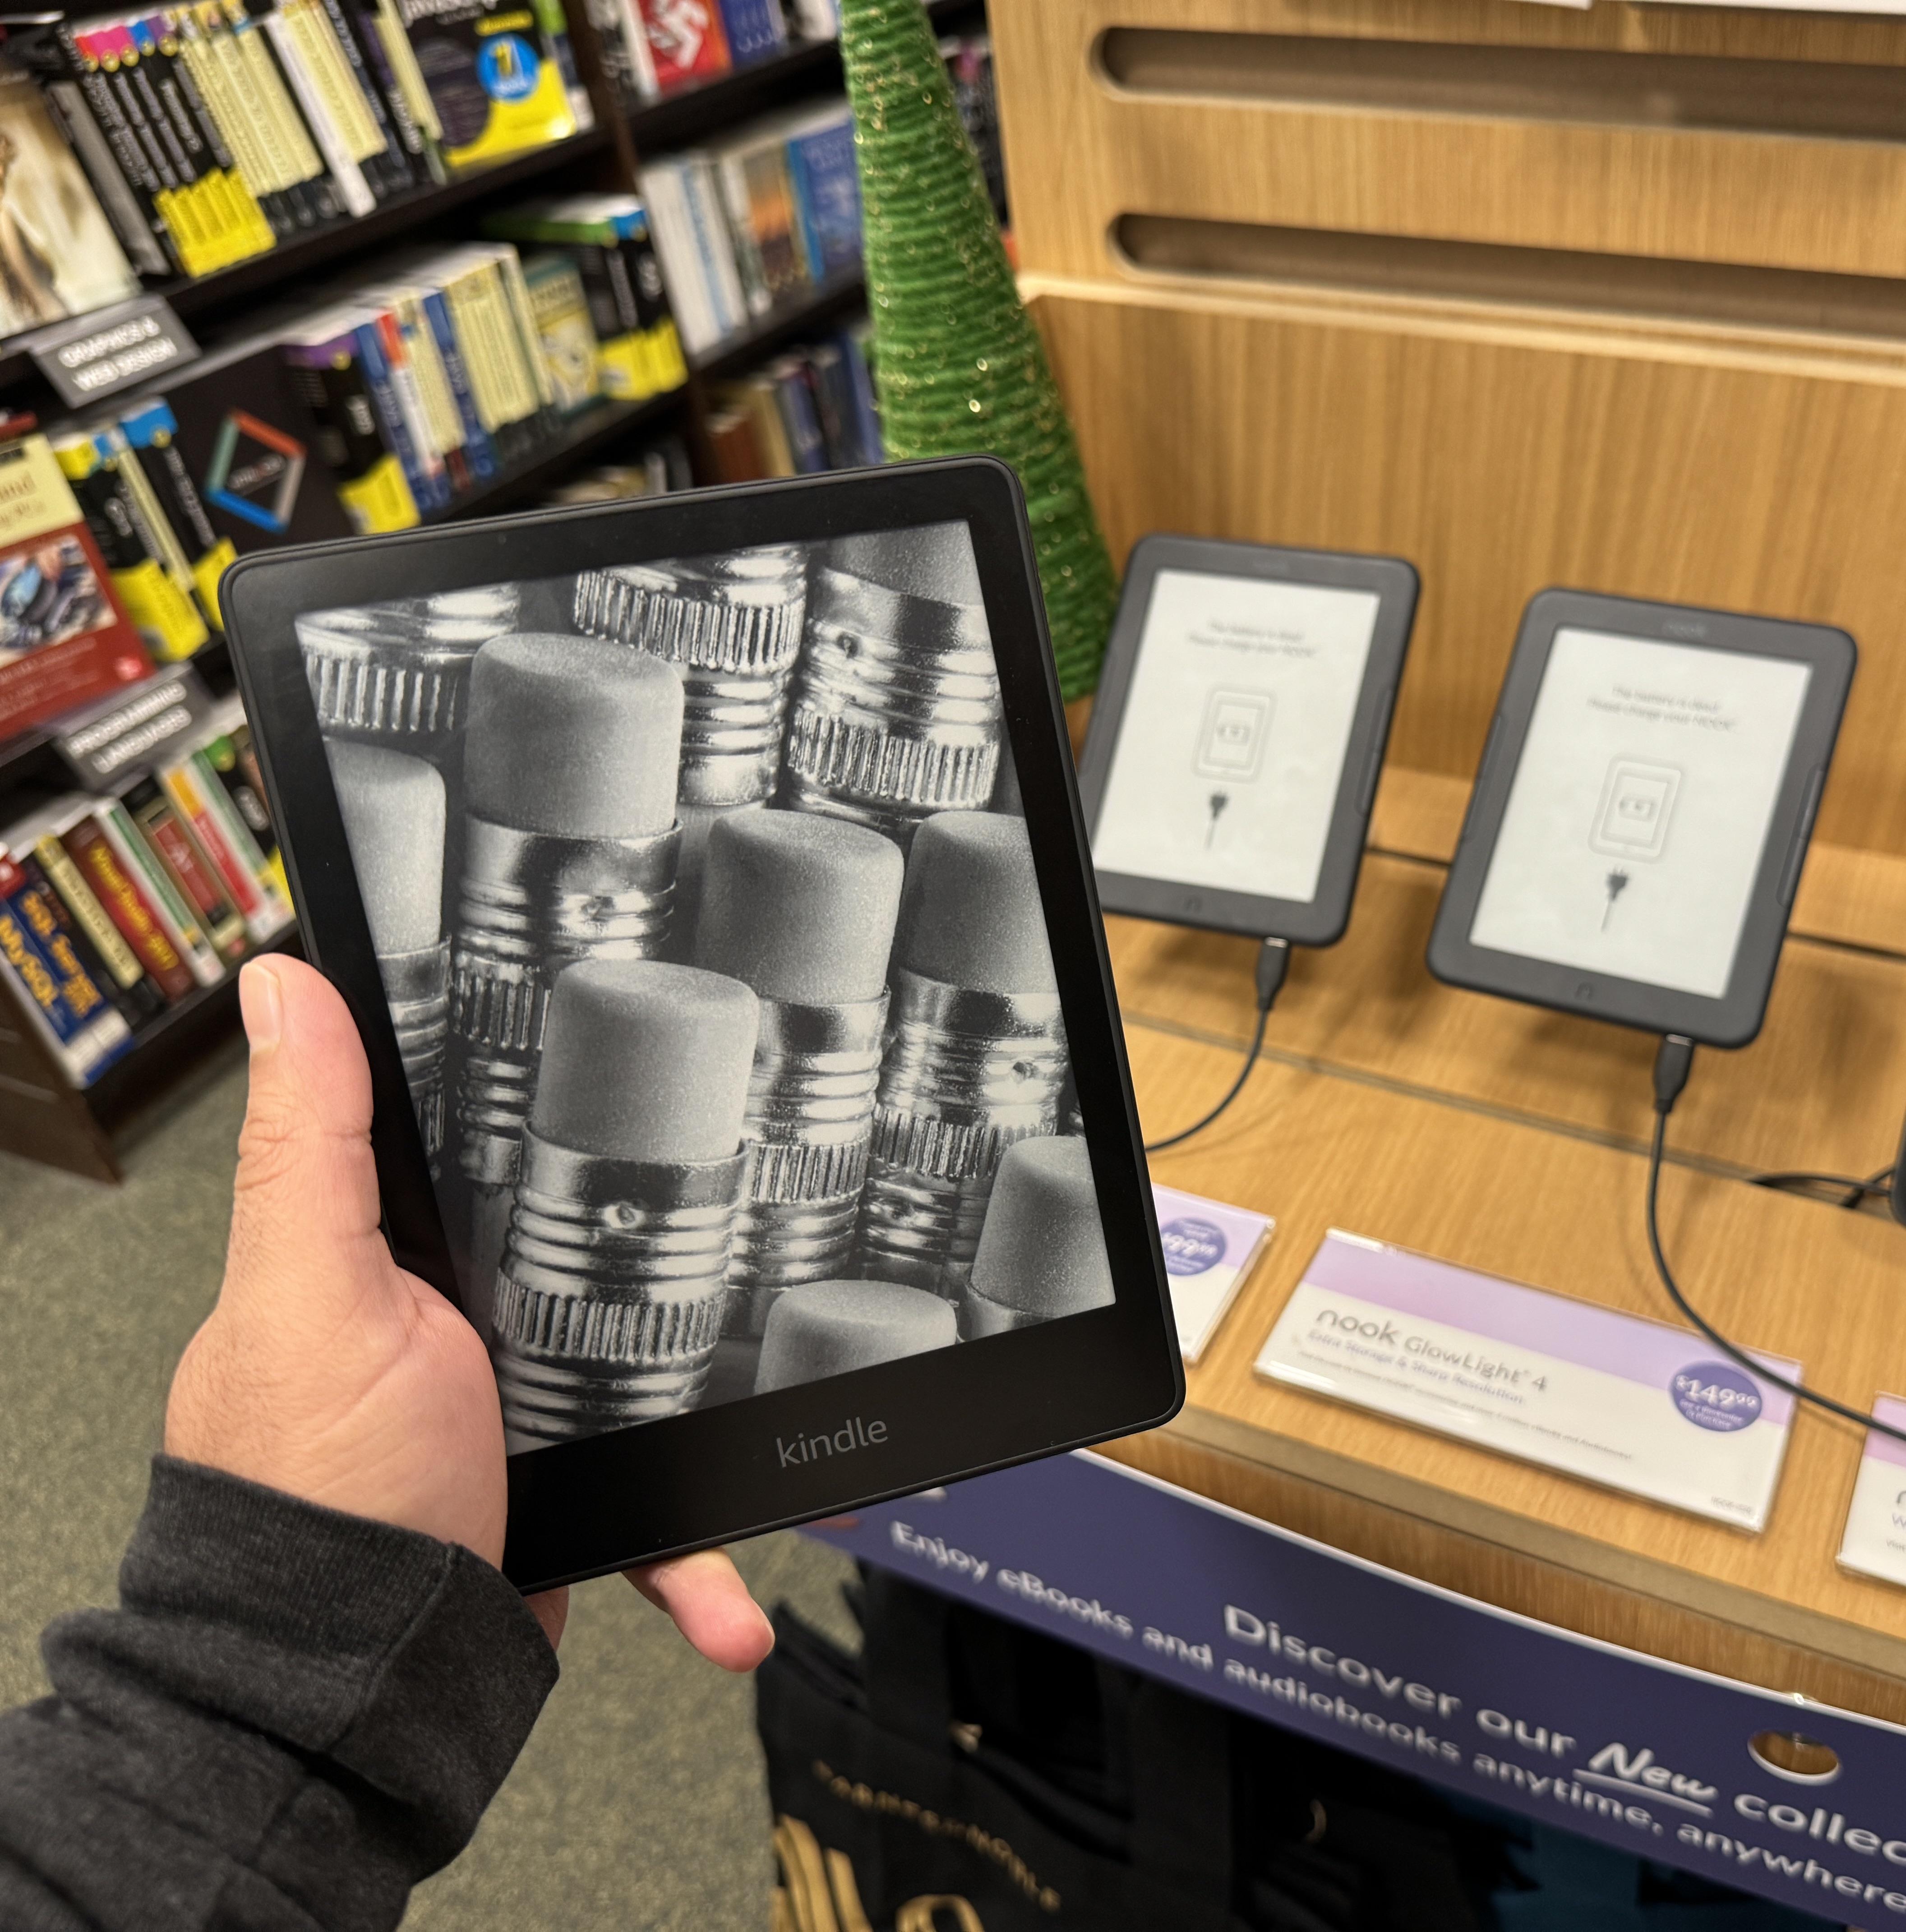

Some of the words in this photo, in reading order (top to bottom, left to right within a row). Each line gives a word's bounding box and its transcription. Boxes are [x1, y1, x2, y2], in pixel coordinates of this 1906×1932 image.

[1316, 1310, 1399, 1346] nook
[1532, 1375, 1548, 1393] 4
[776, 1417, 888, 1468] kindle
[891, 1521, 989, 1584] Enjoy
[997, 1569, 1134, 1639] eBooks
[1142, 1626, 1214, 1672] and
[1223, 1659, 1462, 1765] audiobooks
[1223, 1604, 1462, 1718] Discover
[1476, 1709, 1577, 1758] our
[1587, 1742, 1719, 1803] New
